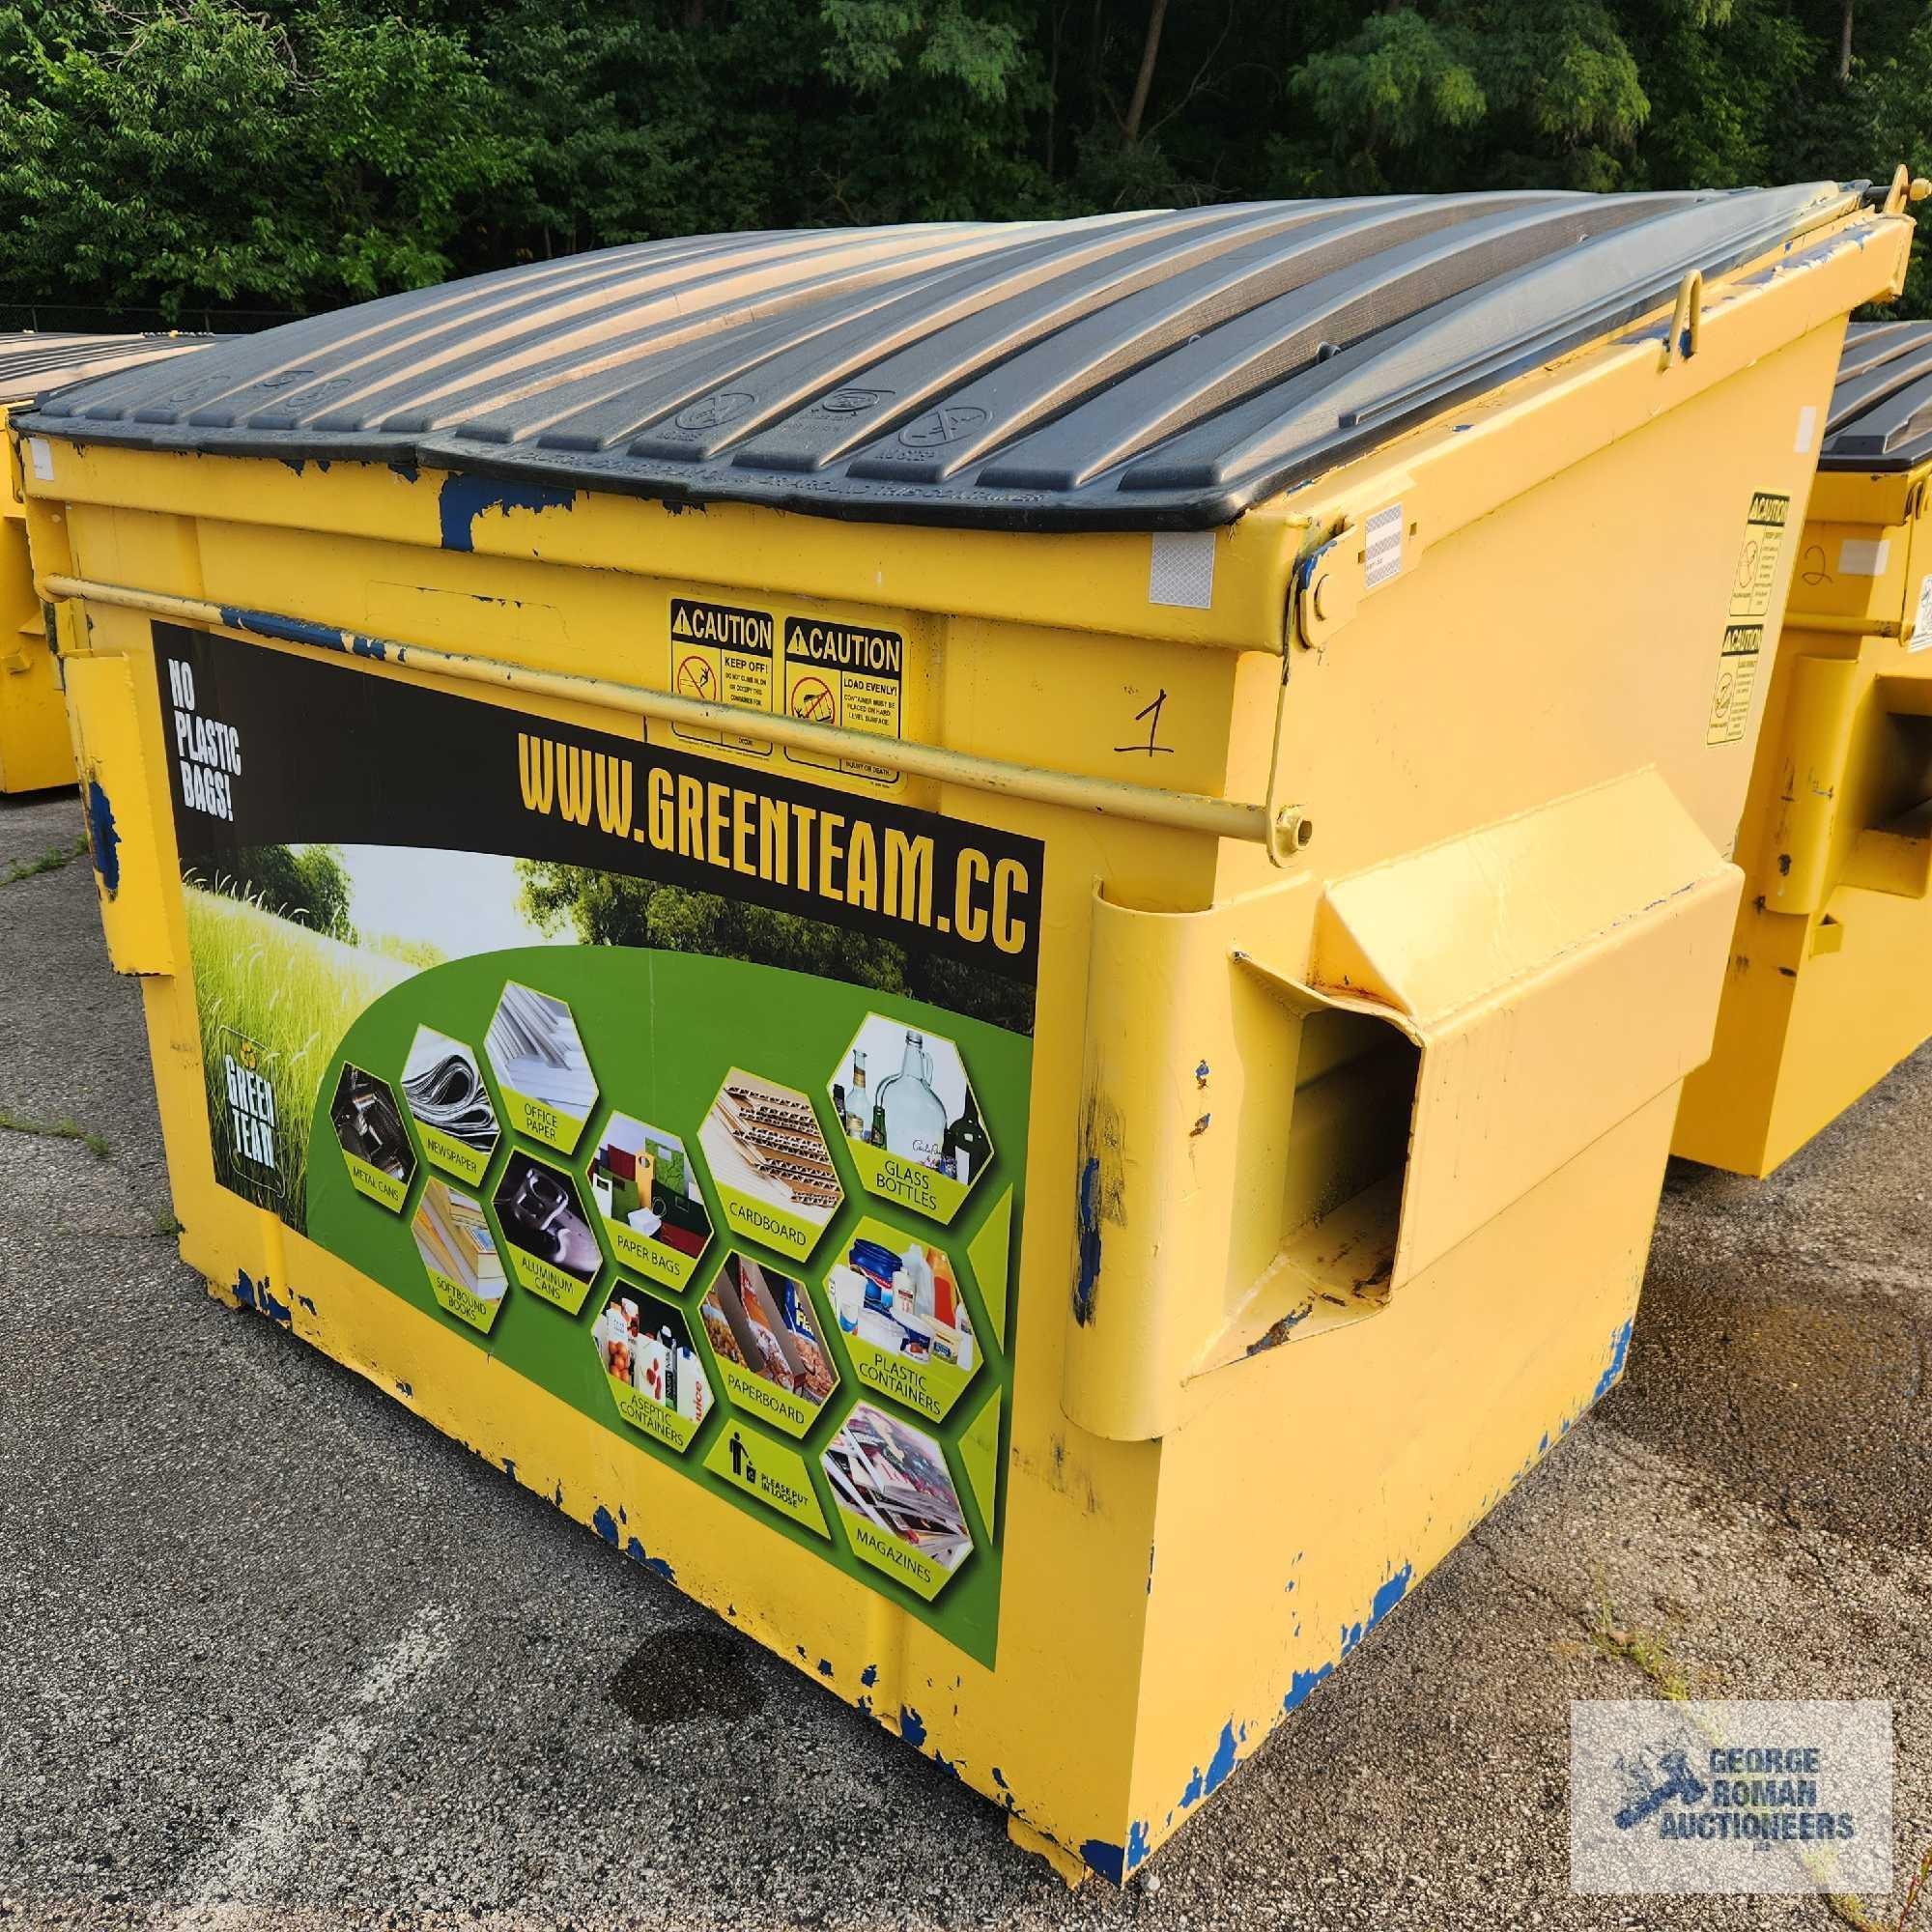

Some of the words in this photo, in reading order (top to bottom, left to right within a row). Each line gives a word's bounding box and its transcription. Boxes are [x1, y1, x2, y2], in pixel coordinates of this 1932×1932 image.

[1802, 545, 1833, 585] 2
[692, 609, 772, 650] CAUTION
[809, 627, 900, 672] CAUTION
[168, 658, 195, 711] NO
[724, 657, 747, 669] KEEP
[749, 662, 769, 675] OFF!
[844, 677, 865, 690] LOAD
[866, 682, 897, 696] EVENLY!
[1114, 689, 1174, 756] 1
[174, 710, 242, 777] PLASTIC
[180, 760, 234, 822] BAGS!
[517, 731, 1030, 955] WWW.GREENTEAM.CC
[225, 1054, 275, 1129] GREEN
[524, 1103, 558, 1128] OFFICE
[526, 1118, 557, 1142] PAPER
[232, 1108, 275, 1169] TEAM
[427, 1138, 478, 1174] NEWSPAPER
[353, 1165, 377, 1190] METAL
[377, 1180, 400, 1203] CANS
[876, 1173, 938, 1211] BOTTLES
[885, 1159, 929, 1191] GLASS
[729, 1201, 807, 1247] CARDBOARD
[522, 1255, 575, 1295] ALUMINUM
[617, 1235, 650, 1264] PAPER
[651, 1250, 681, 1277] BAGS
[436, 1276, 487, 1316] SOFTBOUND
[447, 1295, 477, 1321] BOOKS
[534, 1276, 561, 1301] CANS
[859, 1362, 941, 1416] CONTAINERS
[874, 1353, 927, 1392] PLASTIC
[631, 1394, 672, 1427] ASEPTIC
[727, 1374, 806, 1425] PAPERBOARD
[619, 1401, 684, 1447] CONTAINERS
[761, 1472, 791, 1496] PLEASE
[791, 1490, 809, 1506] PUT
[761, 1481, 770, 1493] IN
[771, 1488, 798, 1509] LOOSE
[857, 1528, 931, 1583] MAGAZINES
